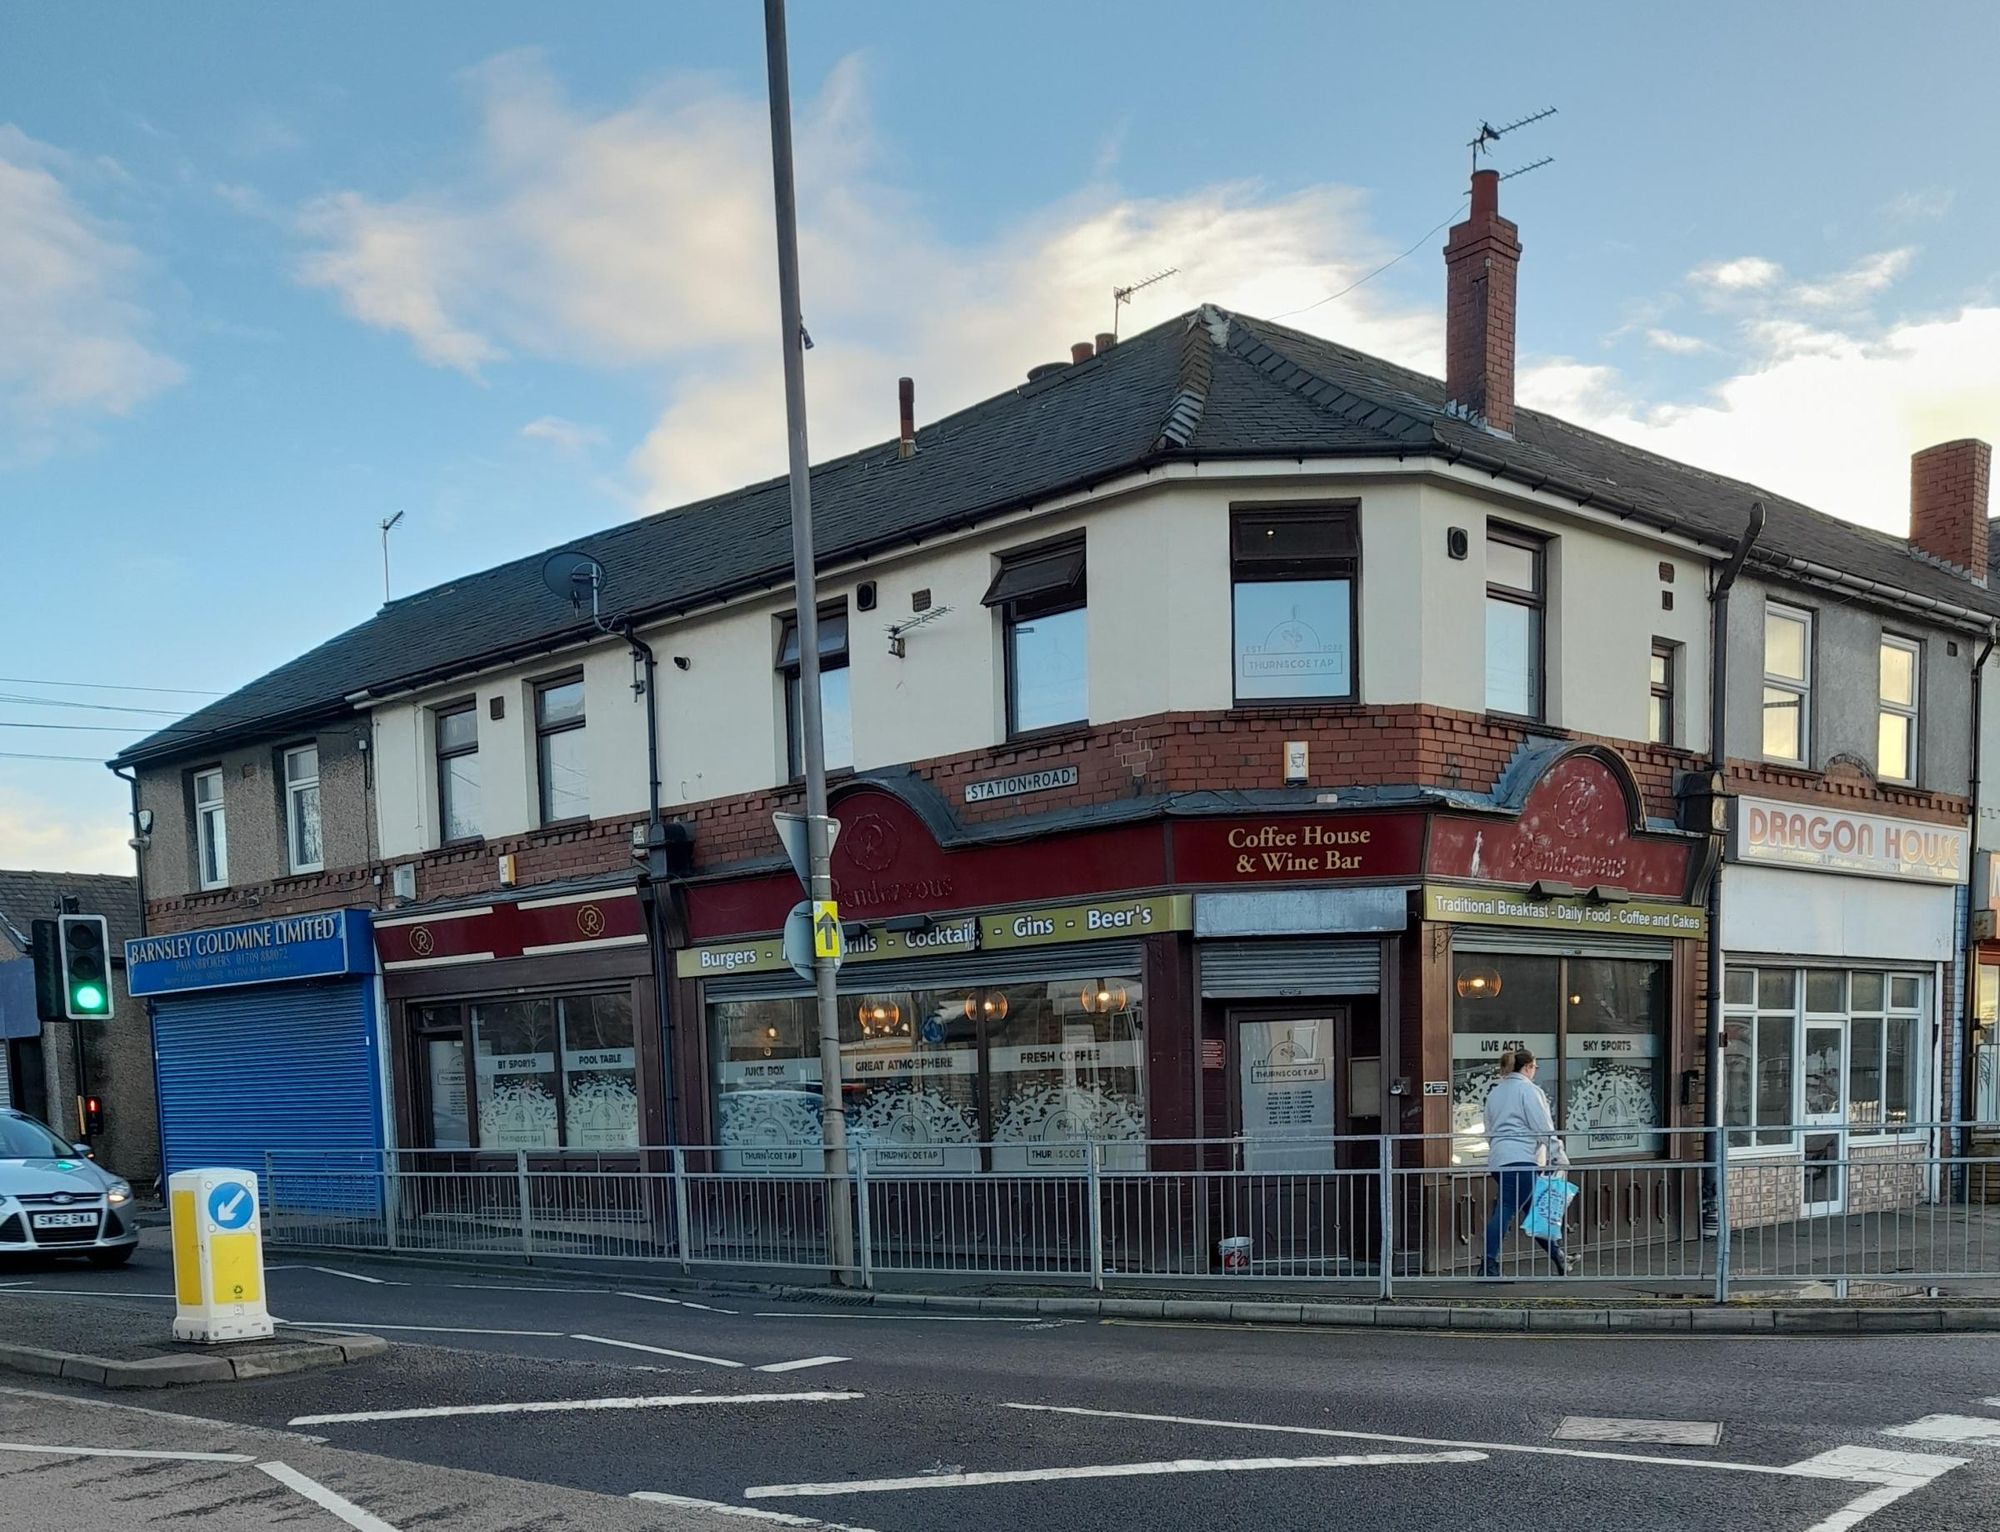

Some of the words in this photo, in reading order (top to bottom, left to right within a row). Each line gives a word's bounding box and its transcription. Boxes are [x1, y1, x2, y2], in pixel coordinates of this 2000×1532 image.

[971, 778, 1027, 799] STATION
[1033, 770, 1071, 788] ROAD
[1228, 826, 1297, 848] Coffee
[1303, 825, 1371, 845] House
[1750, 807, 1873, 857] DRAGON
[1885, 827, 1960, 868] HOUSE
[1236, 854, 1257, 873] &
[1262, 851, 1319, 872] Wine
[1325, 850, 1362, 870] Bar
[584, 910, 599, 931] R
[1435, 895, 1495, 914] Traditional
[1497, 901, 1549, 918] Breakfast
[1557, 905, 1583, 924] Daily
[1585, 908, 1611, 922] Food
[1619, 909, 1650, 926] Coffee
[1652, 913, 1670, 927] and
[1672, 914, 1700, 929] Cakes
[132, 938, 191, 965] BARNSLEY
[196, 927, 271, 956] GOLDMINE
[275, 917, 335, 945] LIMITED
[701, 950, 756, 970] Burgers
[1013, 915, 1054, 937] Gins
[1087, 904, 1152, 929] Beer's
[1481, 1041, 1499, 1051] LIVE
[1502, 1041, 1525, 1051] ACTS
[1583, 1041, 1598, 1050] SKY
[1601, 1041, 1632, 1050] SPORTS
[509, 1058, 537, 1068] SPORTS
[578, 1055, 598, 1064] POOL
[600, 1053, 622, 1063] TABLE
[856, 1060, 884, 1072] GREAT
[888, 1057, 953, 1070] ATMOSPHERE
[1020, 1051, 1055, 1064] FRESH
[1059, 1050, 1101, 1062] COFFEE
[744, 1066, 765, 1077] JUKE
[768, 1065, 785, 1076] BOX
